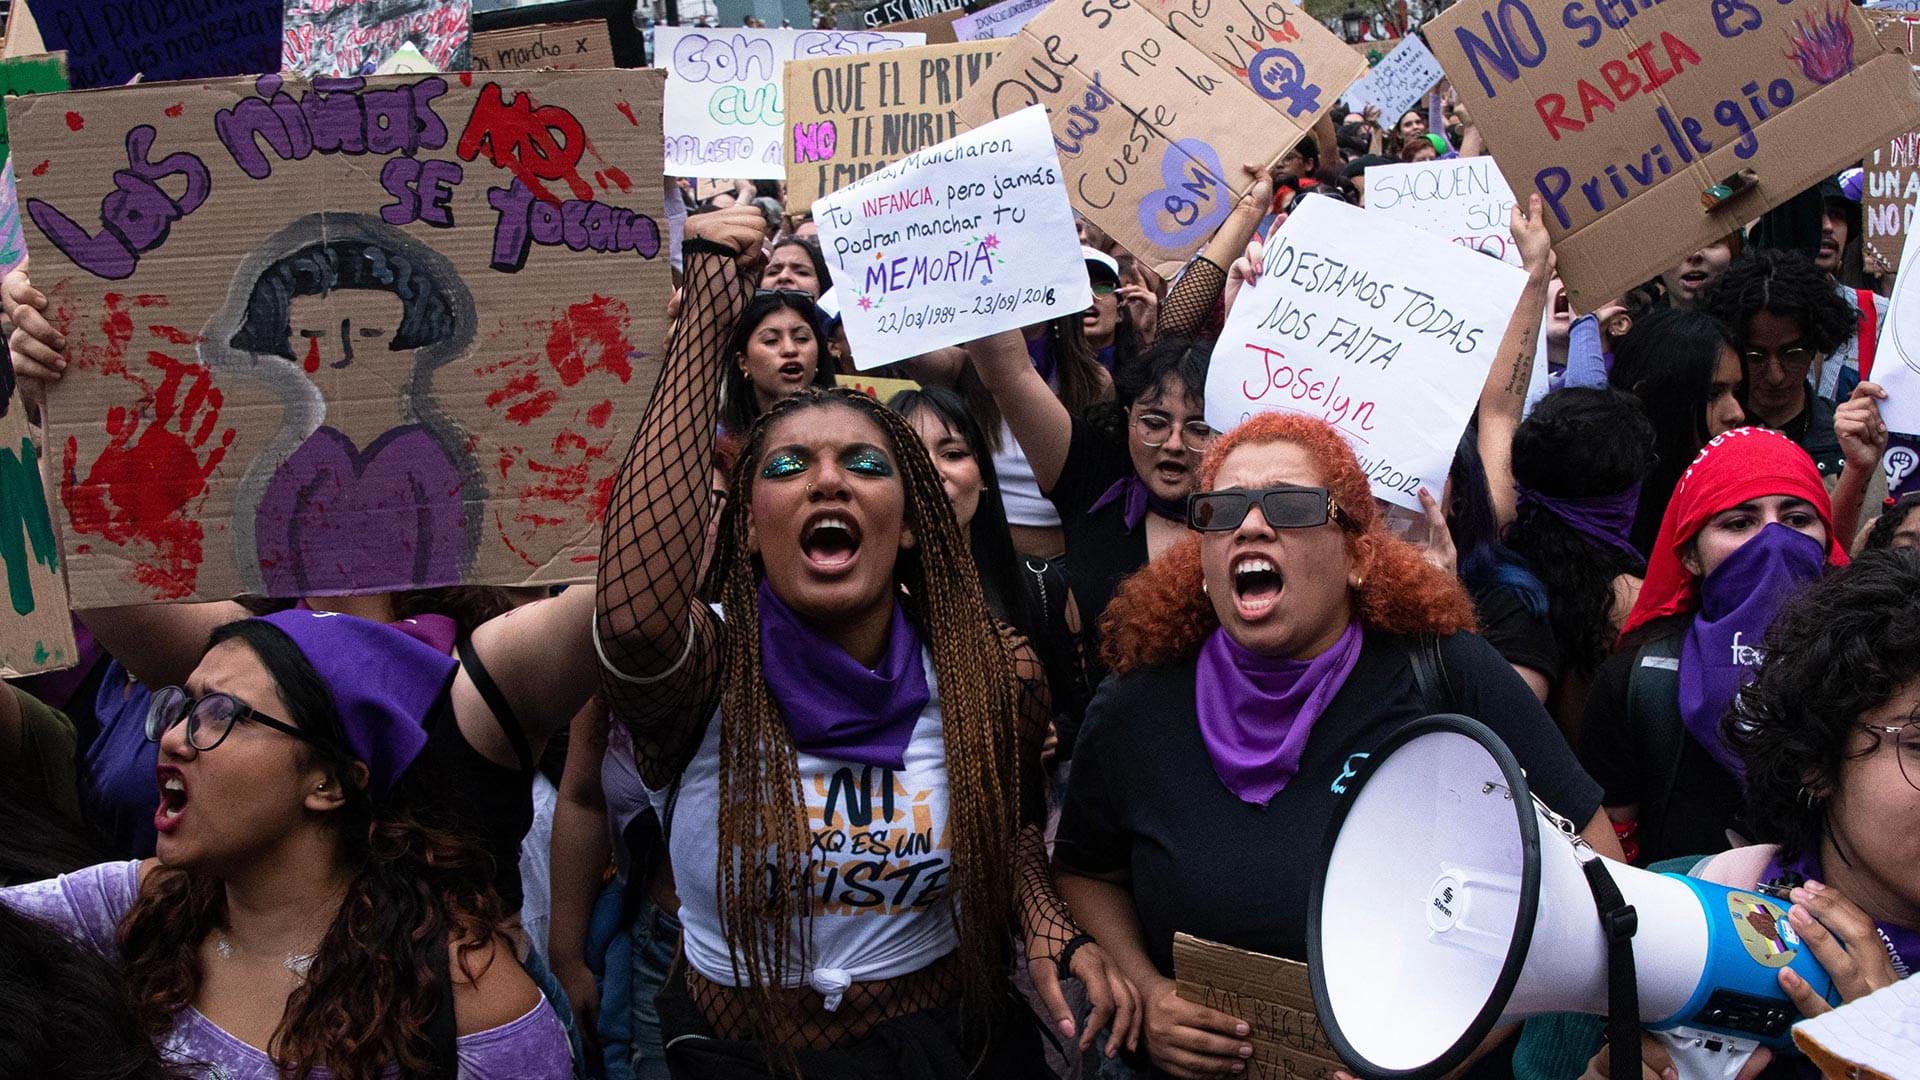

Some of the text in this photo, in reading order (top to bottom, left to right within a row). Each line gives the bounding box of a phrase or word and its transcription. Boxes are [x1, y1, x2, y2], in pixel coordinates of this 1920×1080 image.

[1120, 37, 1162, 77] no
[1454, 0, 1547, 99] NO
[812, 62, 870, 115] QUE
[878, 61, 905, 108] EL
[1534, 31, 1702, 142] RABIA
[793, 120, 838, 164] NO
[1534, 77, 1796, 231] Privilegio
[379, 156, 463, 228] SE
[861, 185, 941, 218] INFANCIA,
[946, 180, 986, 214] pero
[993, 166, 1056, 202] jamás
[1163, 166, 1219, 227] 8M
[1374, 164, 1490, 210] SAQUEN
[906, 212, 982, 242] manchar
[1867, 202, 1901, 239] NO
[864, 241, 994, 295] MEMORIA
[1256, 296, 1318, 341] NOS
[1393, 285, 1484, 355] TODAS
[1242, 343, 1376, 433] Joselyn
[851, 829, 889, 857] ES
[894, 827, 933, 860] UN
[1432, 896, 1453, 918] Steren
